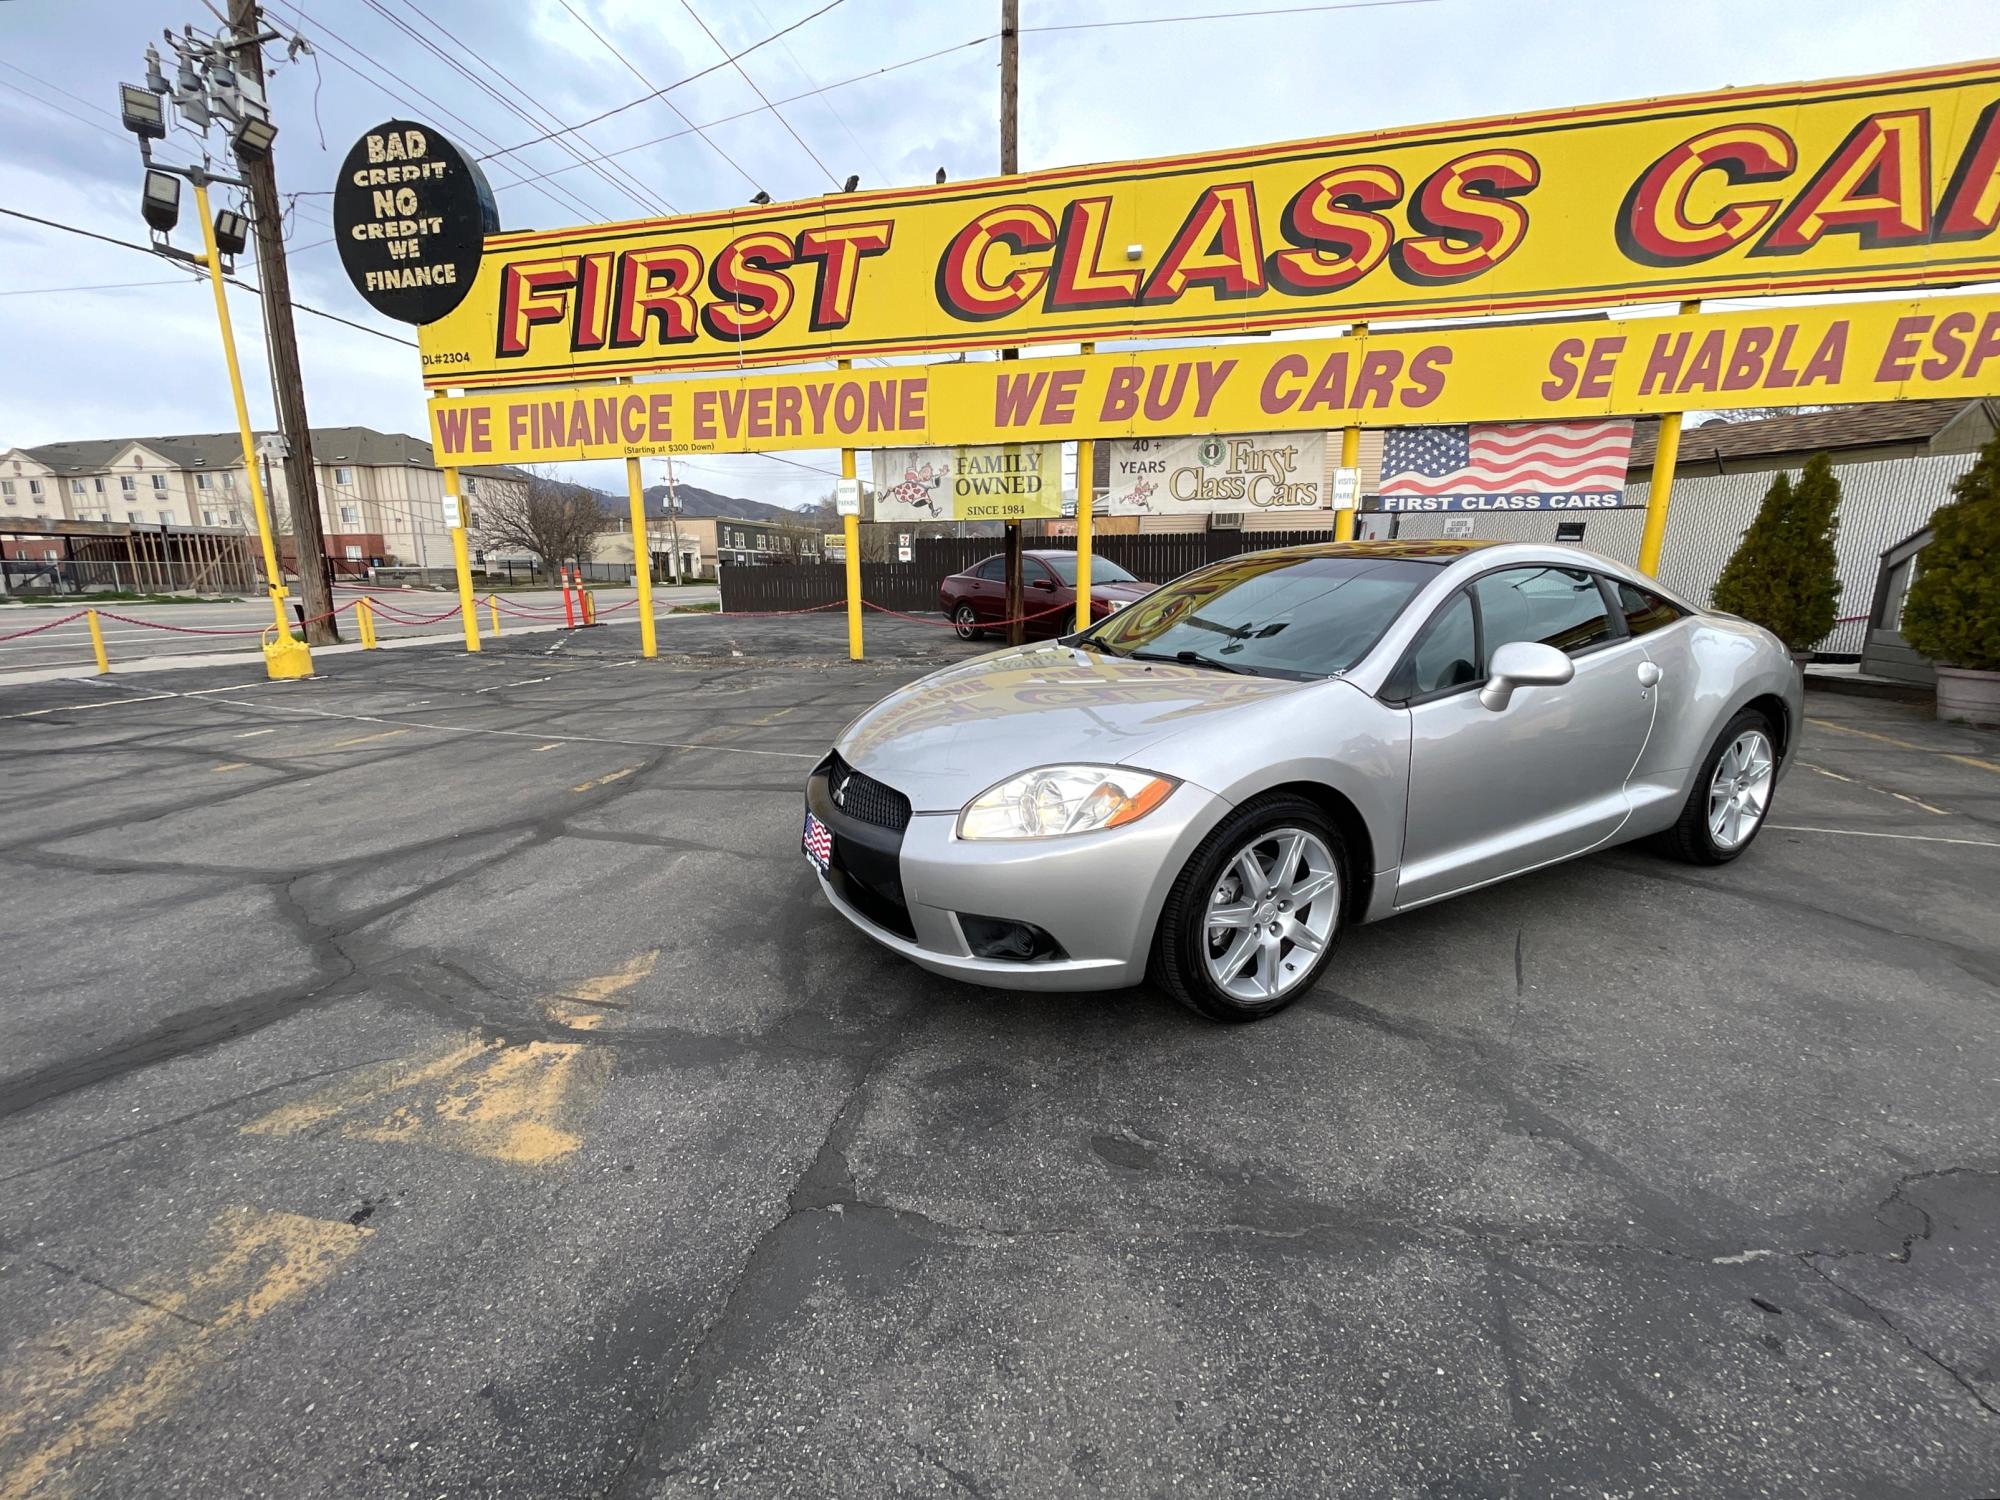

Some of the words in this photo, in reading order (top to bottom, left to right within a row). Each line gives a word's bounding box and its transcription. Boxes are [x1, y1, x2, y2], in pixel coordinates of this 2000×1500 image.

[366, 130, 427, 164] BAD
[353, 161, 447, 187] CREDIT
[372, 187, 418, 219] NO
[351, 217, 443, 241] CREDIT
[387, 238, 421, 260] WE
[496, 220, 895, 359] FIRST
[935, 149, 1540, 322] CLASS
[365, 263, 457, 292] FINANCE
[422, 352, 470, 365] DL#2304
[437, 407, 491, 453] WE
[509, 394, 672, 451] FINANCE
[693, 378, 928, 440] EVERYONE
[994, 369, 1085, 428] WE
[1100, 359, 1239, 422] BUY
[1260, 345, 1453, 413] CARS
[1541, 335, 1627, 401] SE
[1638, 320, 1849, 396] HABLA
[624, 446, 656, 455] (Starting
[668, 444, 688, 453] $300
[691, 442, 715, 451] Down)
[1132, 439, 1149, 452] 40
[955, 453, 1042, 475] FAMILY
[1120, 460, 1166, 474] YEARS
[1226, 439, 1298, 486] First
[955, 475, 1042, 496] OWNED
[1169, 466, 1246, 501] Class
[1247, 474, 1318, 507] Cars
[967, 505, 1000, 516] SINCE
[1002, 505, 1025, 515] 1984
[1384, 497, 1453, 511] FIRST
[1461, 496, 1541, 510] CLASS
[1549, 494, 1618, 509] CARS
